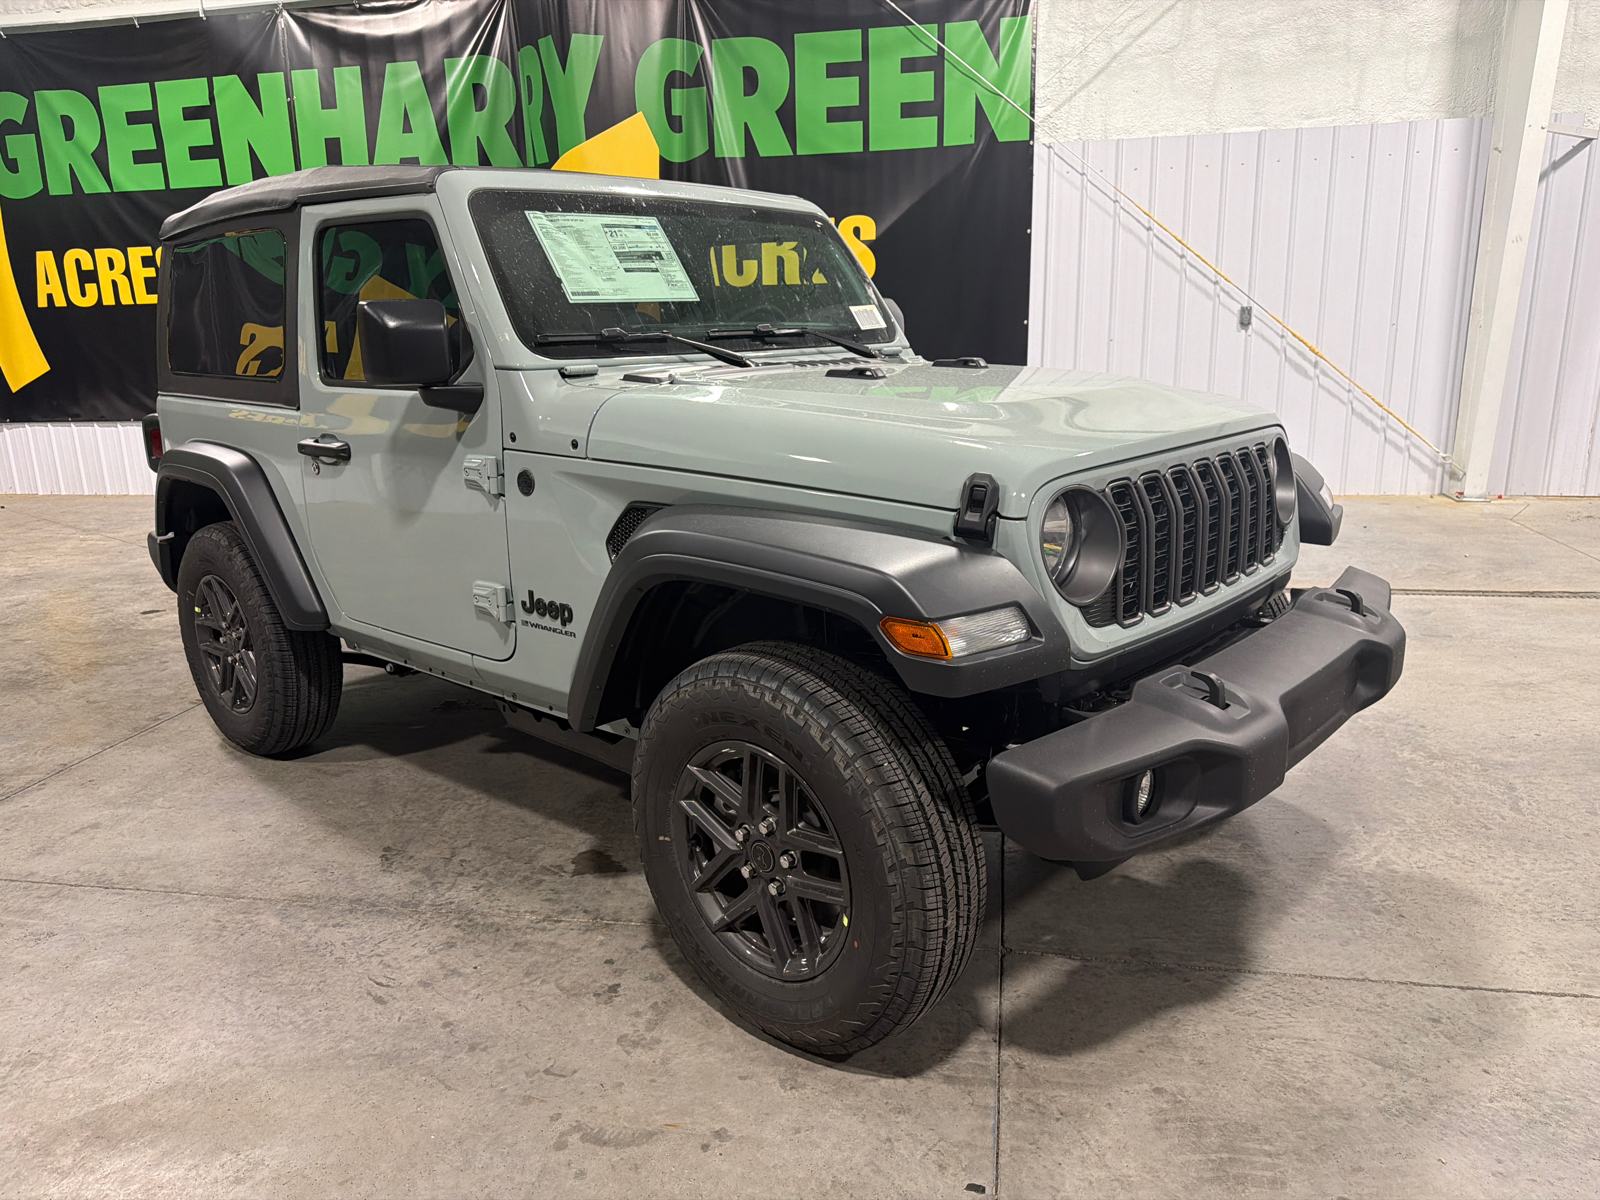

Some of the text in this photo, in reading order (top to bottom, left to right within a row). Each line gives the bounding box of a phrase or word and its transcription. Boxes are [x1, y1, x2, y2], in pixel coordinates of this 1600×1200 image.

[291, 15, 1034, 168] HARRY GREEN
[0, 71, 295, 199] GREEN
[36, 245, 163, 308] ACRE
[520, 589, 574, 628] Jeep
[528, 620, 577, 638] WRANGLER
[699, 710, 805, 762] NEXEN
